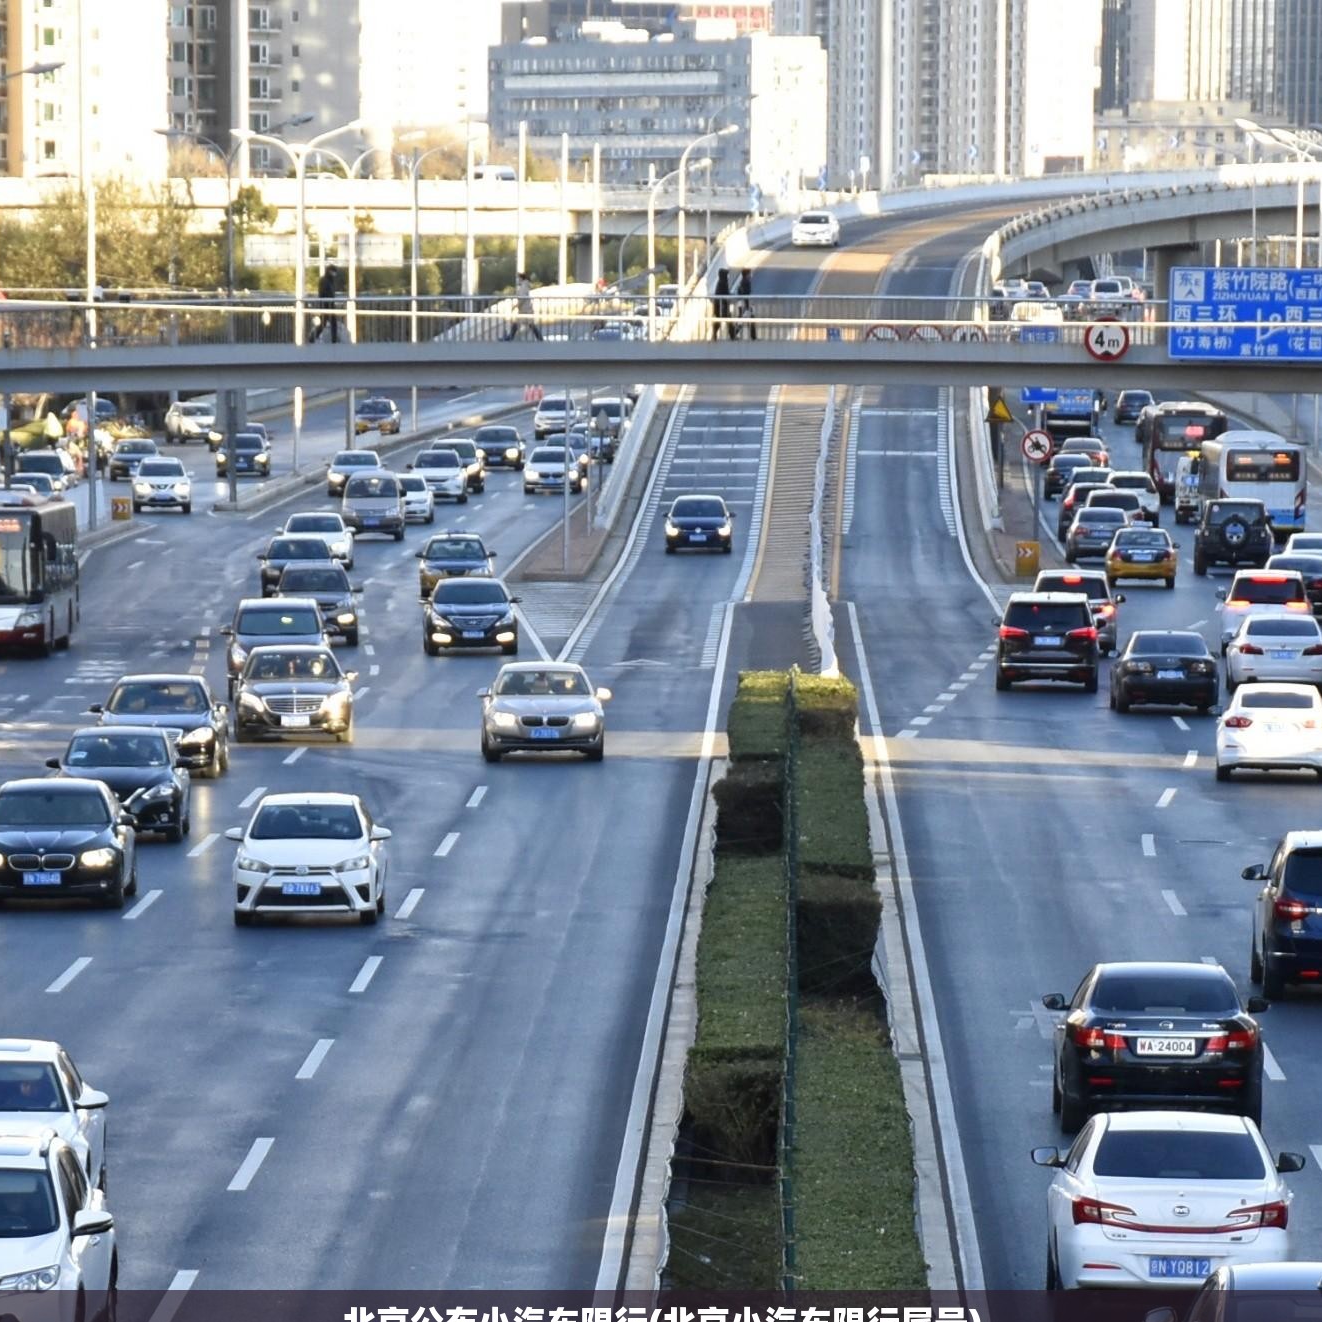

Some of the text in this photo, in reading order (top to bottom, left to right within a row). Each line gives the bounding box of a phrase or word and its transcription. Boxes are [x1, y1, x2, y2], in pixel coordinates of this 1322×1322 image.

[1212, 272, 1288, 291] 紫竹院路
[1174, 305, 1237, 322] 西三环
[1094, 331, 1120, 348] 4m
